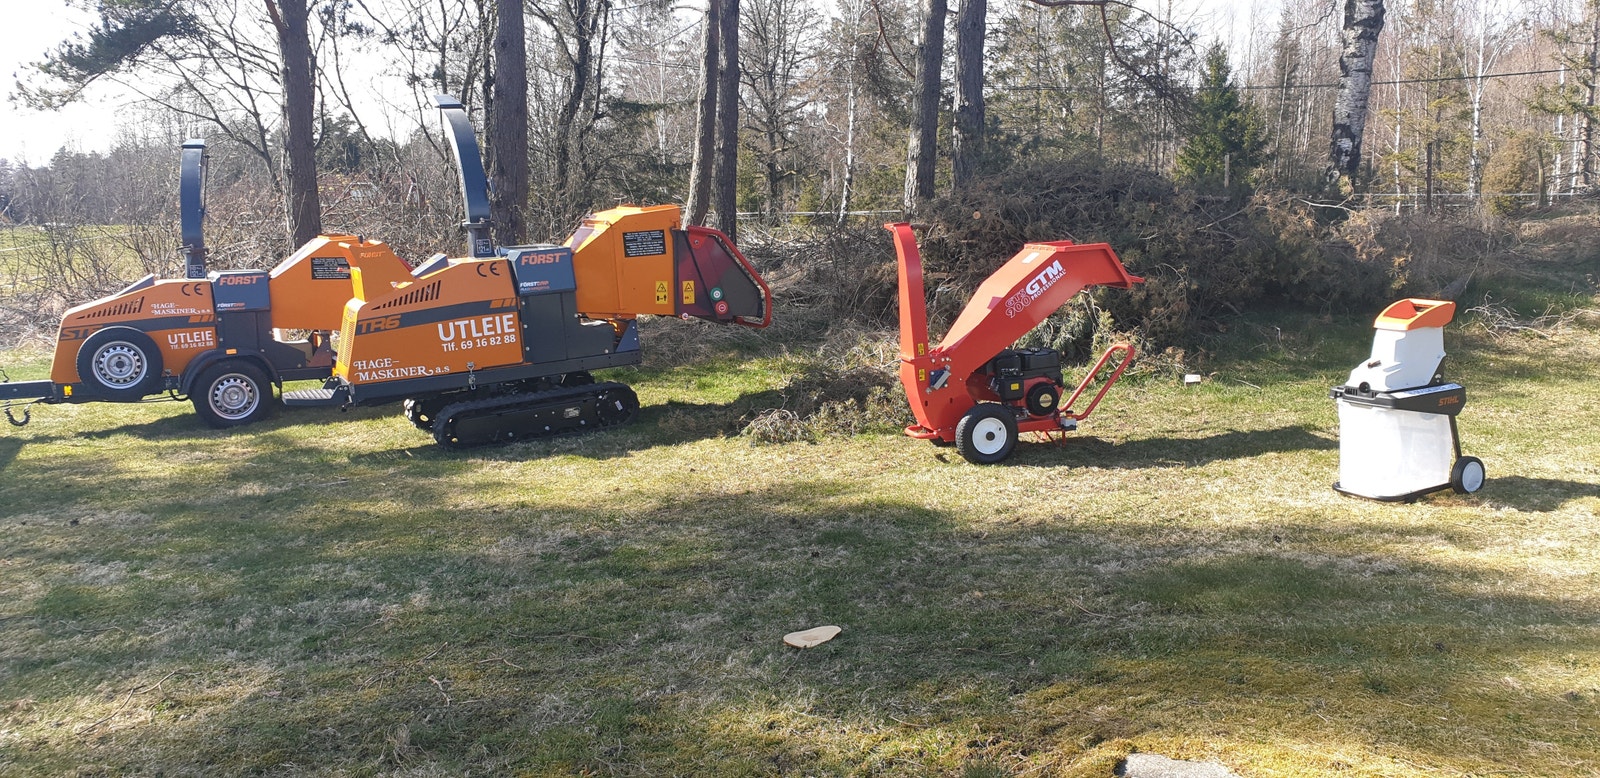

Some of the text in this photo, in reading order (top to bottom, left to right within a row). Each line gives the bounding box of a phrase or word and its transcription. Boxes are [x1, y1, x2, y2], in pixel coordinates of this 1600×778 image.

[521, 252, 568, 266] FÖRST
[220, 275, 265, 286] FÖRST
[1025, 259, 1063, 296] GTM
[1030, 269, 1067, 301] PROFESSIONAL
[1005, 295, 1031, 319] 900
[358, 314, 401, 334] TR6
[438, 314, 516, 342] UTLEIE
[168, 330, 214, 345] UTLEIE
[442, 334, 516, 352] Tlf. 69 16 82 88
[354, 365, 434, 382] MASKINER
[1438, 395, 1460, 407] STIHL
